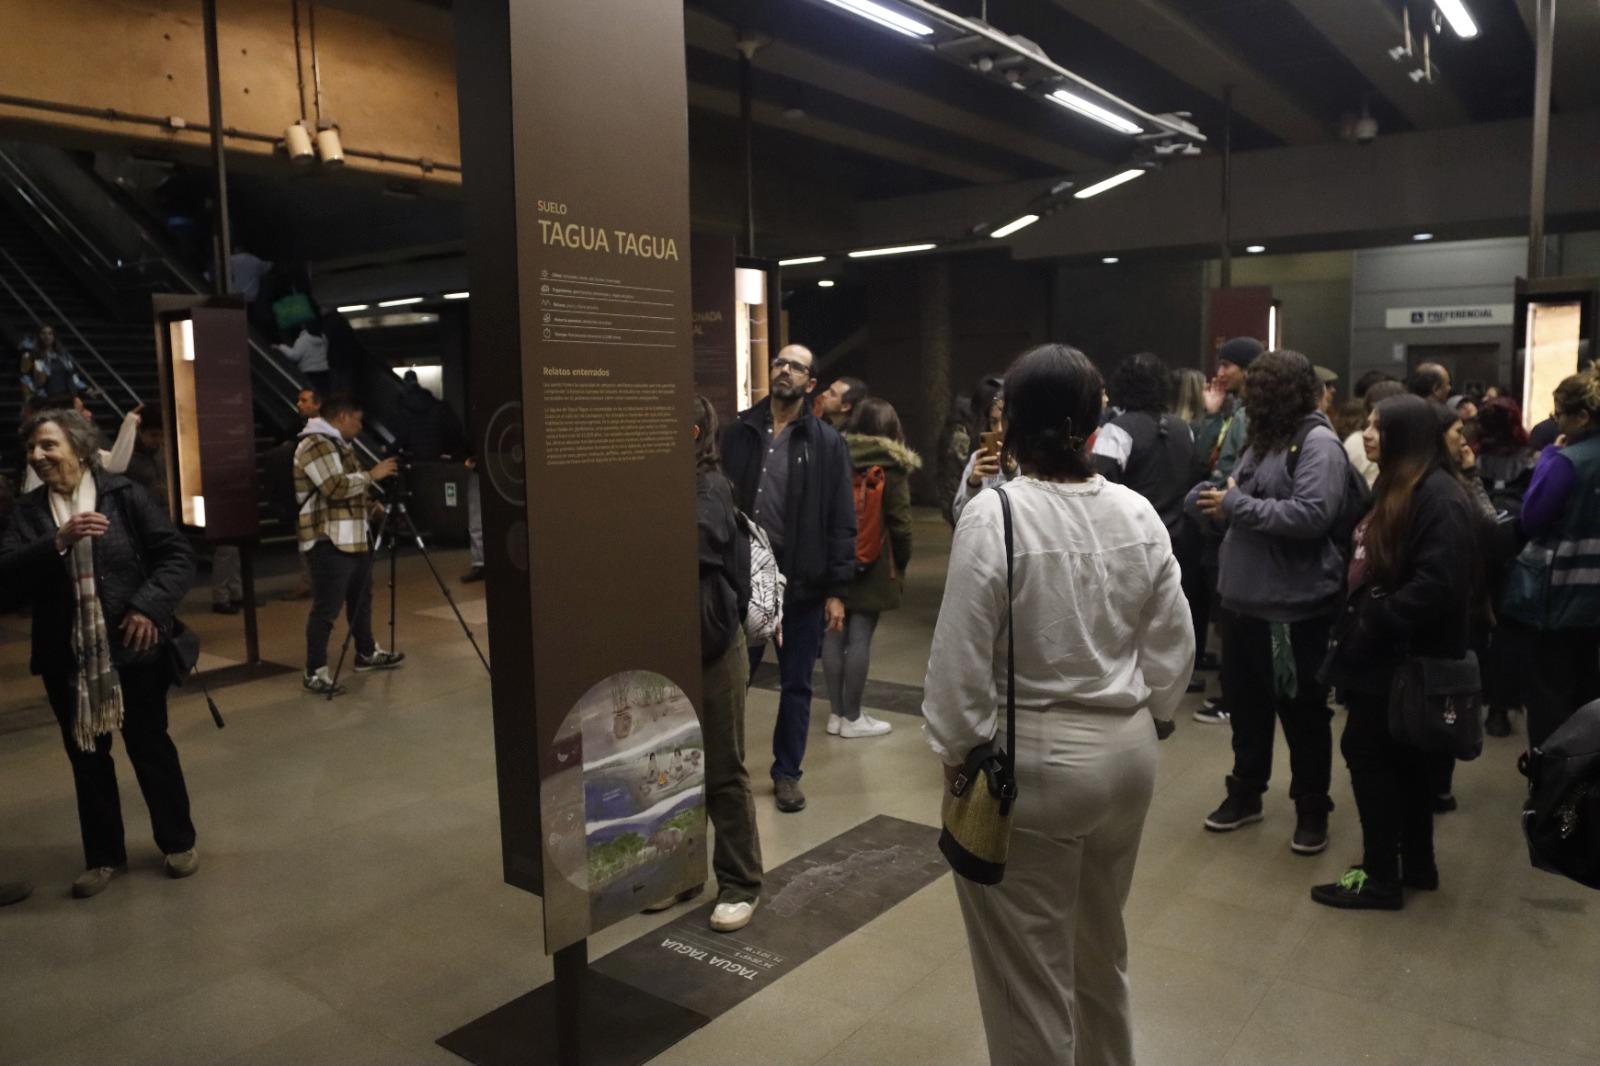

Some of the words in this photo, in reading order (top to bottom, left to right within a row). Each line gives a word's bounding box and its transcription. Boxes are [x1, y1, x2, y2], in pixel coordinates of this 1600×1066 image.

[537, 200, 567, 215] SUELO
[537, 219, 609, 252] TAGUA
[614, 231, 679, 261] TAGUA
[1427, 309, 1492, 321] PREFERENCIAL
[543, 367, 571, 376] Relatos
[573, 368, 610, 377] enterrados
[661, 938, 708, 961] TAGUA
[708, 955, 758, 979] TAGUA
